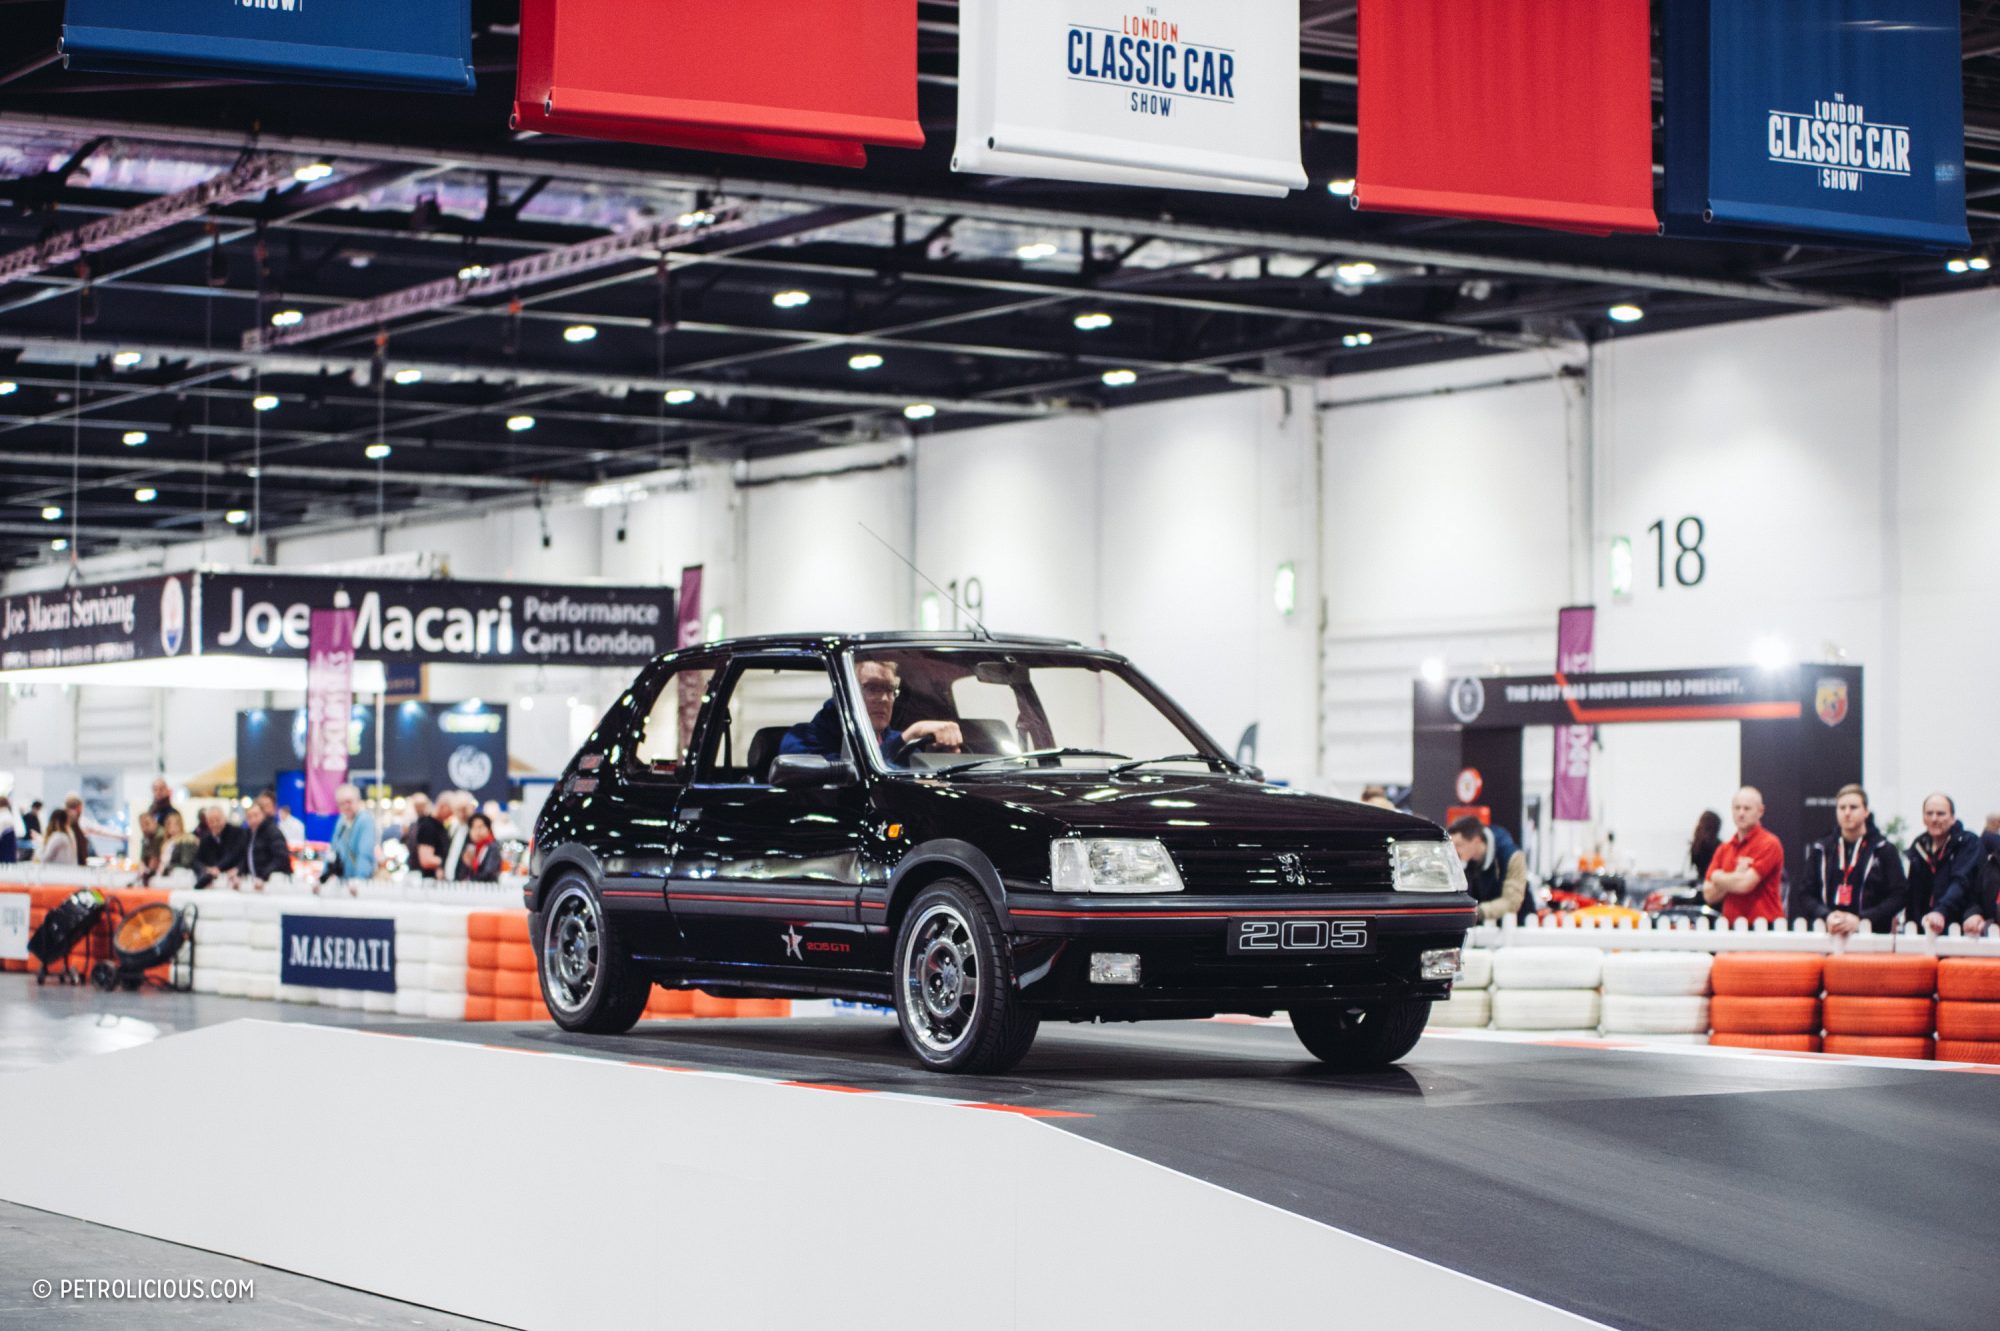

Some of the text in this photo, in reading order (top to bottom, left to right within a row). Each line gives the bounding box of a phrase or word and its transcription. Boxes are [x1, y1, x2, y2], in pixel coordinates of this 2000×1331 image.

[1146, 6, 1158, 17] THE
[1123, 15, 1179, 43] LONDON
[1067, 29, 1235, 98] CLASSIC CAR
[1131, 91, 1172, 117] SHOW
[1834, 91, 1845, 102] THE
[1815, 100, 1863, 125] LONDON
[1768, 114, 1911, 172] CLASSIC CAR
[1822, 168, 1859, 191] SHOW
[1648, 516, 1705, 588] 18
[2, 597, 26, 640] Joe
[72, 585, 136, 634] Servicing
[523, 595, 660, 625] Performance
[947, 576, 983, 633] 19
[217, 587, 514, 655] Joe Macari
[522, 626, 656, 655] Cars London
[1239, 920, 1368, 950] 205
[289, 934, 391, 972] MASERATI
